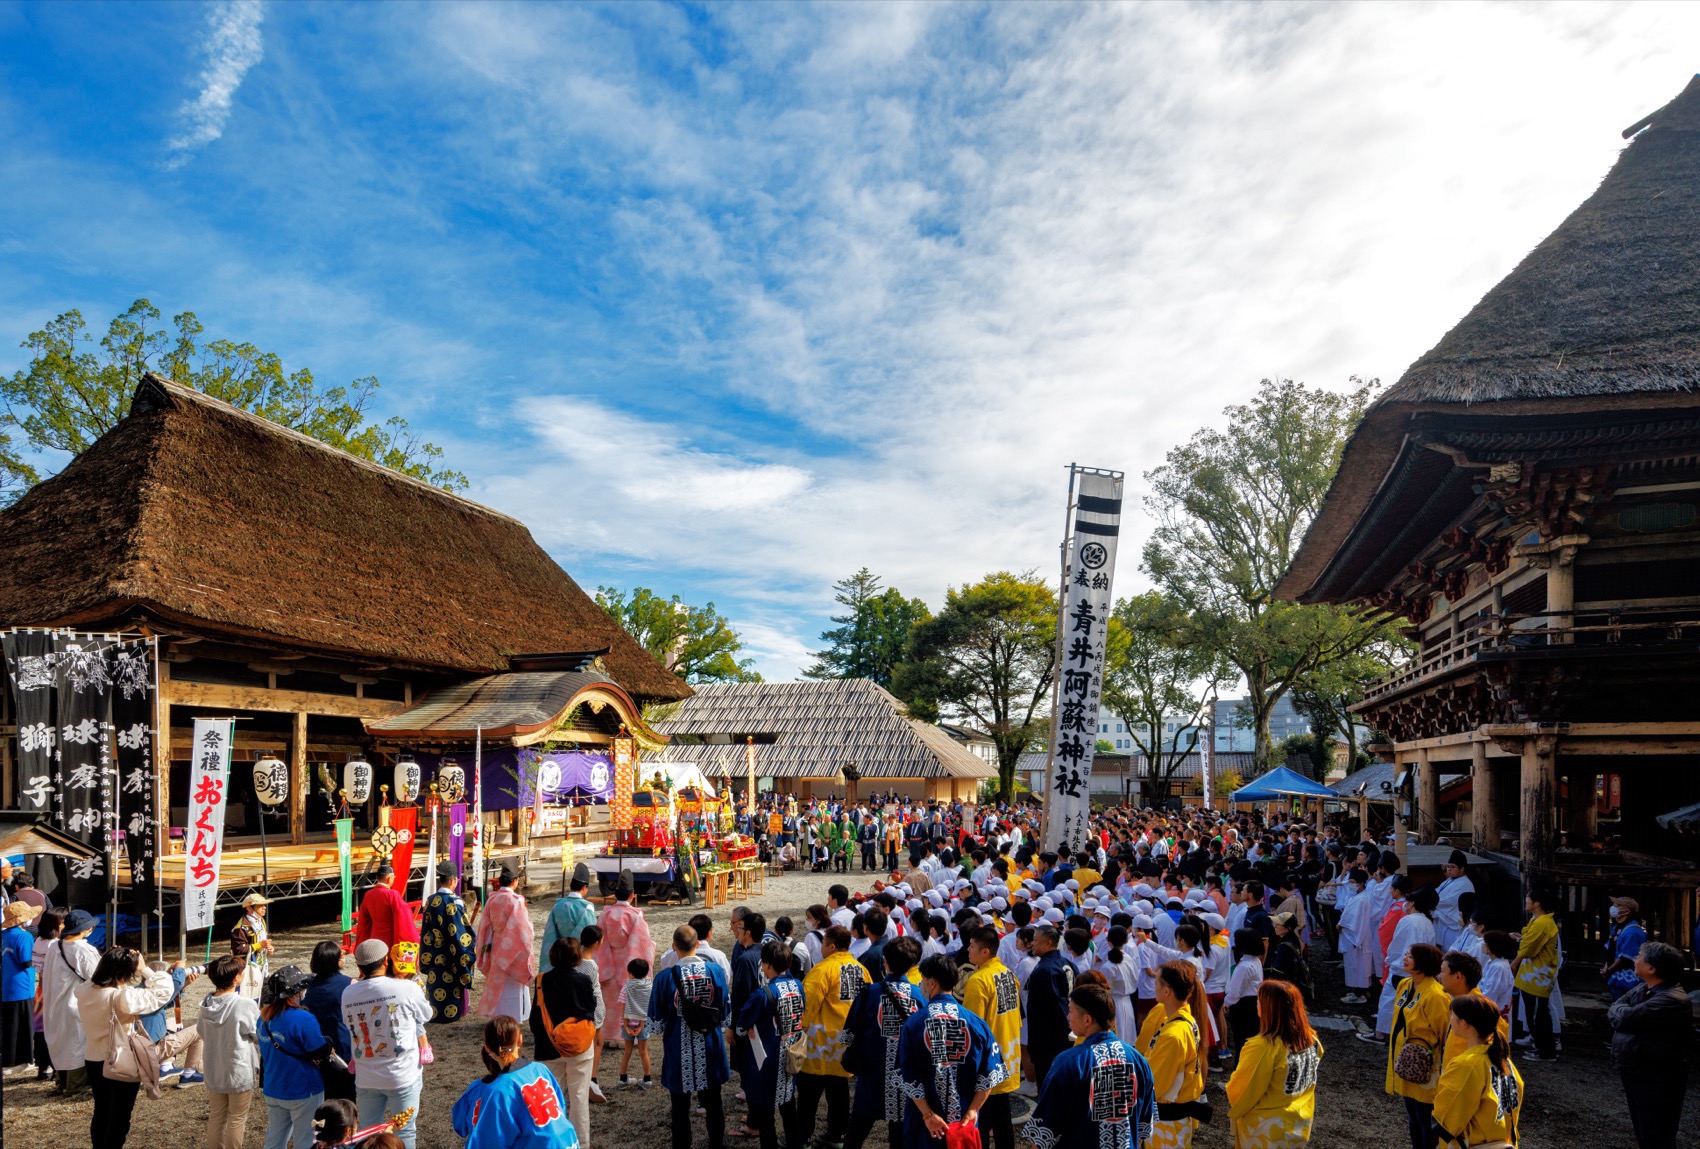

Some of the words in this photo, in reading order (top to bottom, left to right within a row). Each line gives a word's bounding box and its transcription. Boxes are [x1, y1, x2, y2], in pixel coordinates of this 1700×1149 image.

[1073, 567, 1109, 592] 奉納
[1053, 598, 1097, 799] 青井阿蘇神社
[200, 730, 223, 772] 祭禮
[189, 775, 224, 888] おくんち
[197, 889, 206, 919] 氏子中
